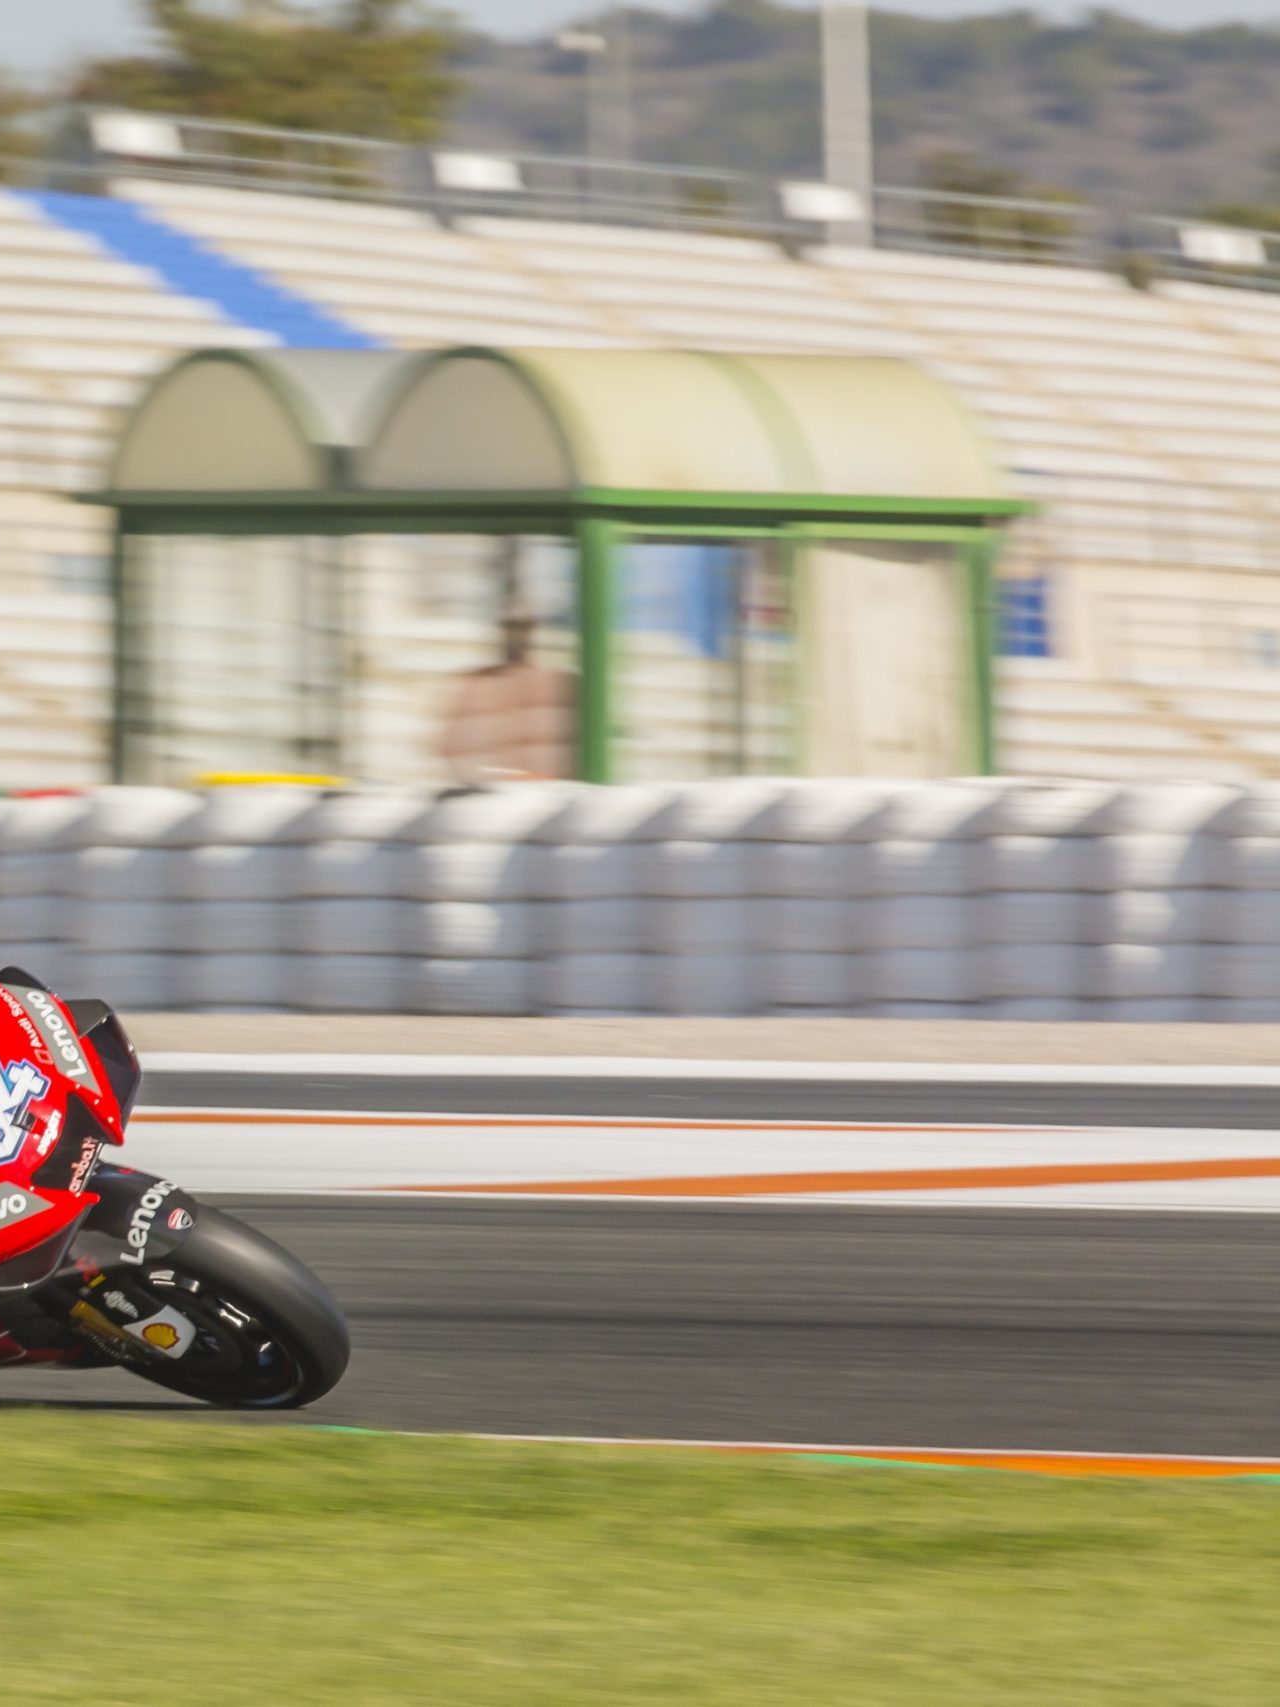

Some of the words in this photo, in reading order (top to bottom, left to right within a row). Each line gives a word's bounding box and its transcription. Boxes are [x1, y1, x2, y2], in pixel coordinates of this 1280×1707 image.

[17, 1017, 43, 1048] Audi
[27, 991, 87, 1077] Lenovo
[120, 1180, 179, 1266] Lenovo
